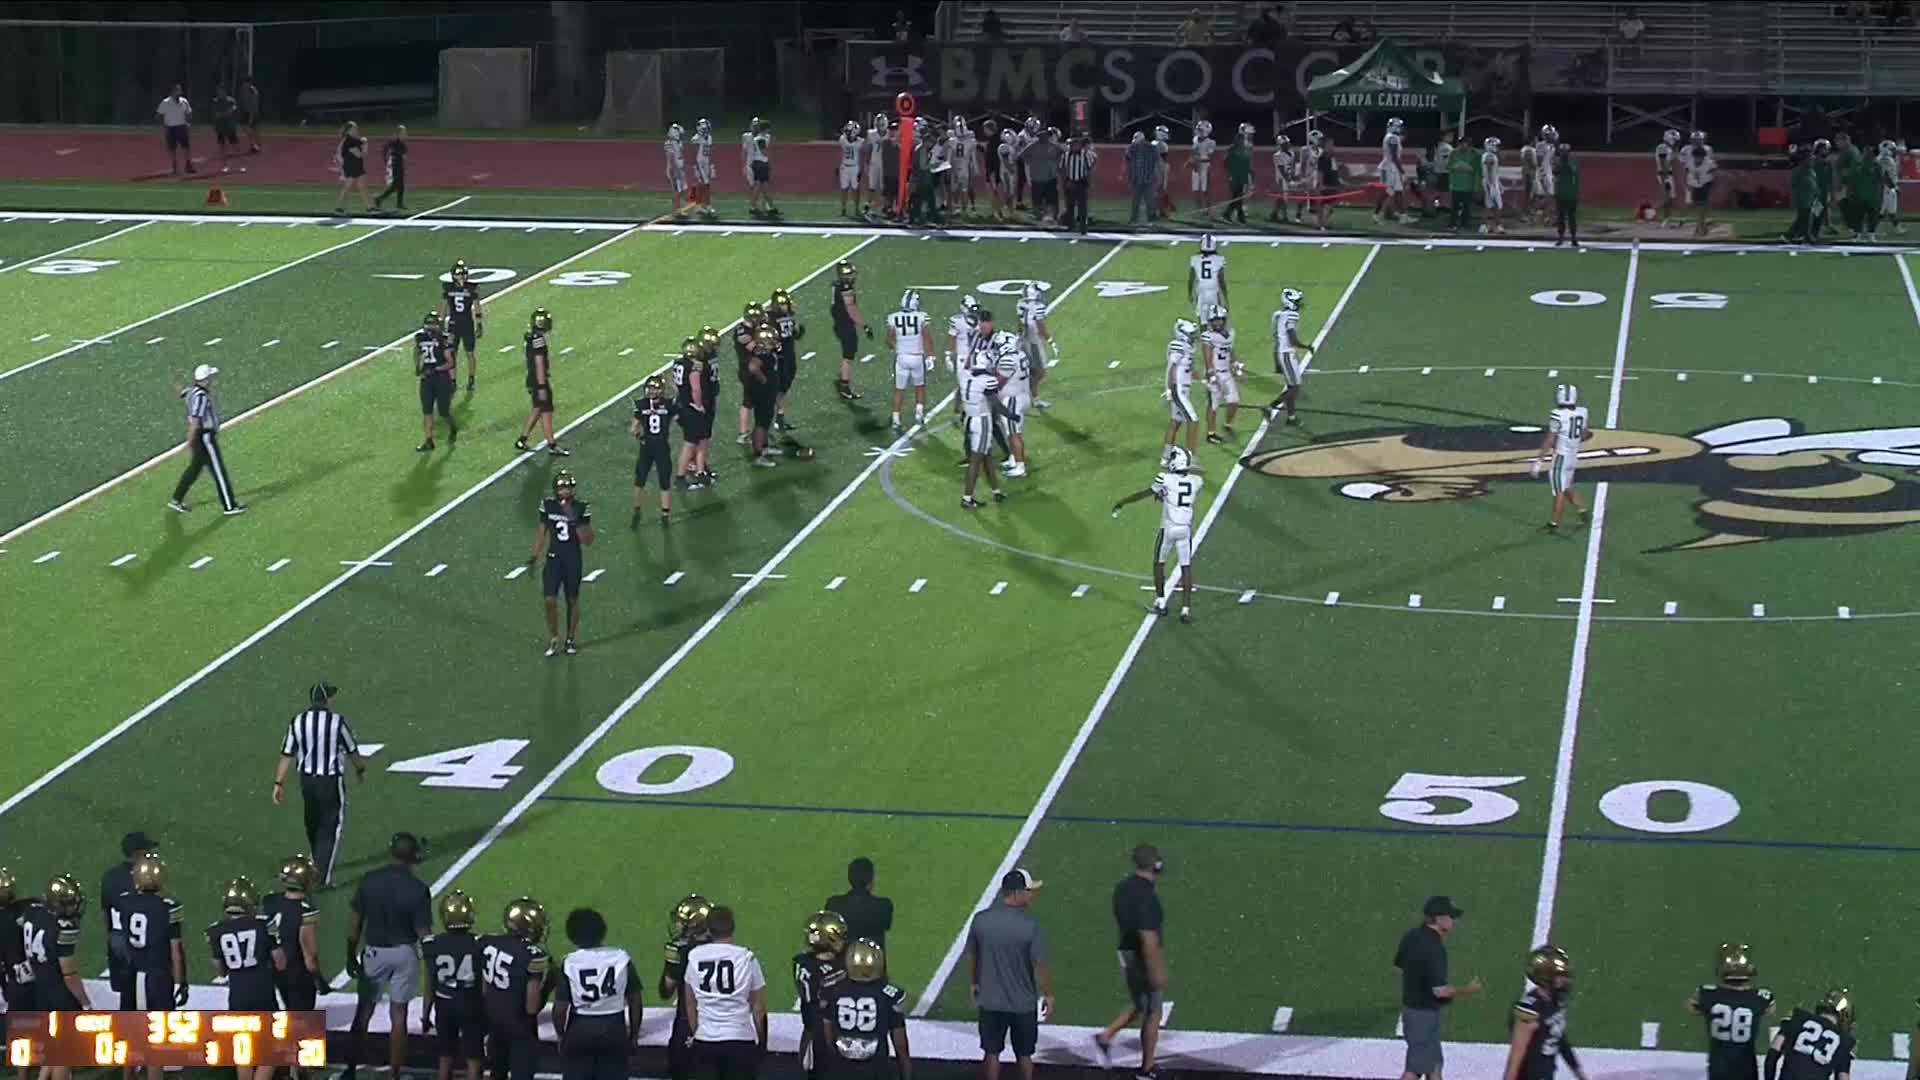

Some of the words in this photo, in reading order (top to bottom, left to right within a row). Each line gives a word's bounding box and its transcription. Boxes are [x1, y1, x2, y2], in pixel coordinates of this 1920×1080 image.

[1333, 94, 1372, 107] TAMPA
[1378, 93, 1437, 107] CATHOLIC
[1201, 261, 1212, 279] 6
[454, 296, 465, 312] 5
[894, 315, 918, 337] 44
[649, 415, 661, 434] 8
[1568, 416, 1584, 439] 18
[1177, 481, 1192, 507] 2
[555, 520, 569, 541] 3
[129, 912, 148, 948] 9
[220, 929, 258, 970] 87
[434, 954, 475, 988] 24
[482, 945, 514, 990] 35
[578, 965, 616, 1002] 54
[698, 959, 735, 995] 70
[836, 996, 877, 1033] 68
[1711, 1003, 1753, 1043] 28
[1793, 1019, 1841, 1066] 23
